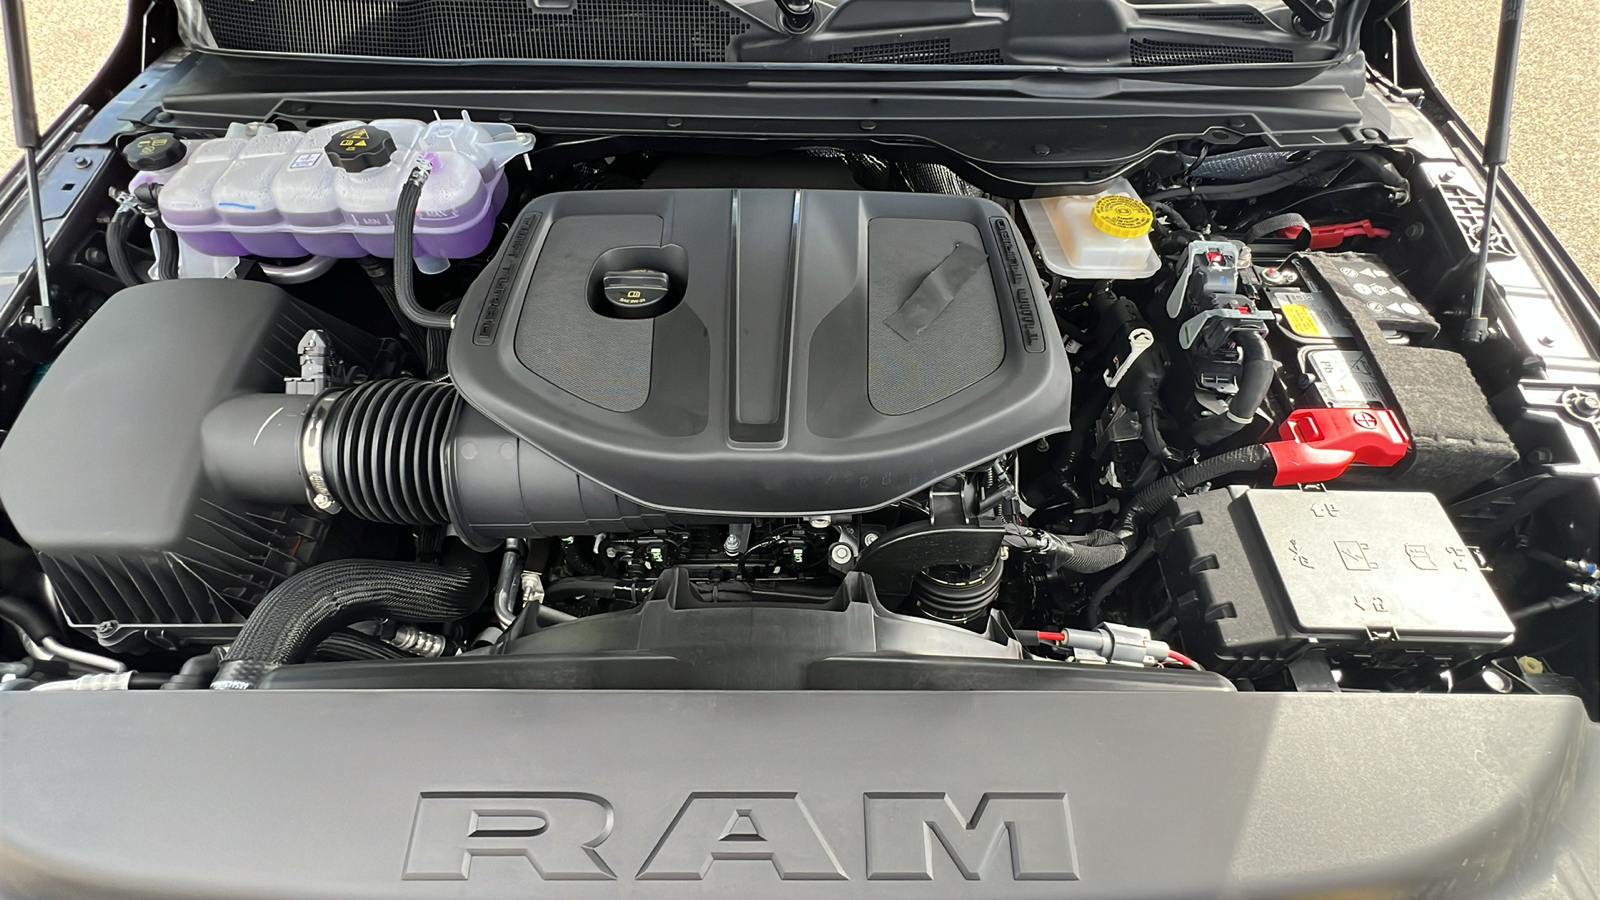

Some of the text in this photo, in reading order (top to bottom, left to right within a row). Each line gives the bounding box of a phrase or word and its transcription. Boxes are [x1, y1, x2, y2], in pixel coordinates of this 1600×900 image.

[479, 263, 516, 339] TURBO
[995, 218, 1039, 346] TWIN TURBO
[402, 791, 1081, 881] RAM
